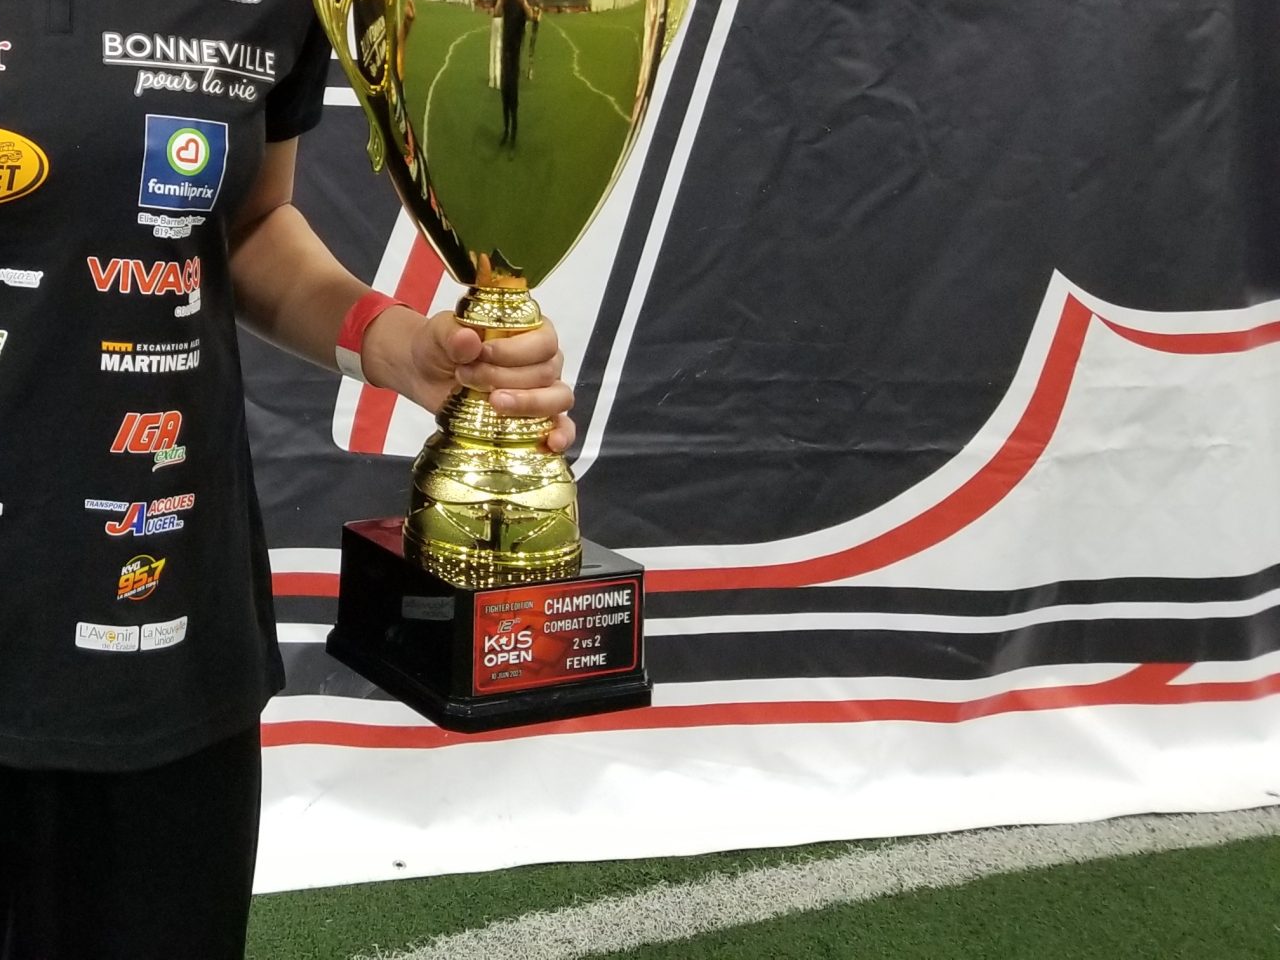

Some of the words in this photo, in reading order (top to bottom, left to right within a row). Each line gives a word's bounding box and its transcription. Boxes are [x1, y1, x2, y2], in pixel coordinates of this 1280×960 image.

[103, 32, 275, 74] BONNEVILLE
[134, 69, 198, 96] pour
[203, 67, 224, 94] la
[229, 79, 257, 100] vie
[148, 178, 214, 200] familiprix
[136, 343, 188, 351] EXCAVATION
[101, 350, 200, 372] MARTINEAU
[110, 411, 182, 453] IGA
[154, 445, 185, 462] extra
[86, 500, 128, 510] TRANSPORT
[118, 558, 165, 596] 95.7
[485, 603, 510, 614] FIGHTER
[544, 589, 631, 615] CHAMPIONNE
[544, 617, 584, 633] COMBAT
[586, 611, 631, 628] D'ÉQUIPE
[79, 625, 134, 643] L'Avenir
[143, 628, 153, 638] La
[484, 631, 533, 652] KJS
[573, 638, 580, 650] 2
[582, 639, 592, 648] vs
[594, 635, 601, 647] 2
[484, 650, 533, 667] OPEN
[566, 653, 607, 669] FEMME
